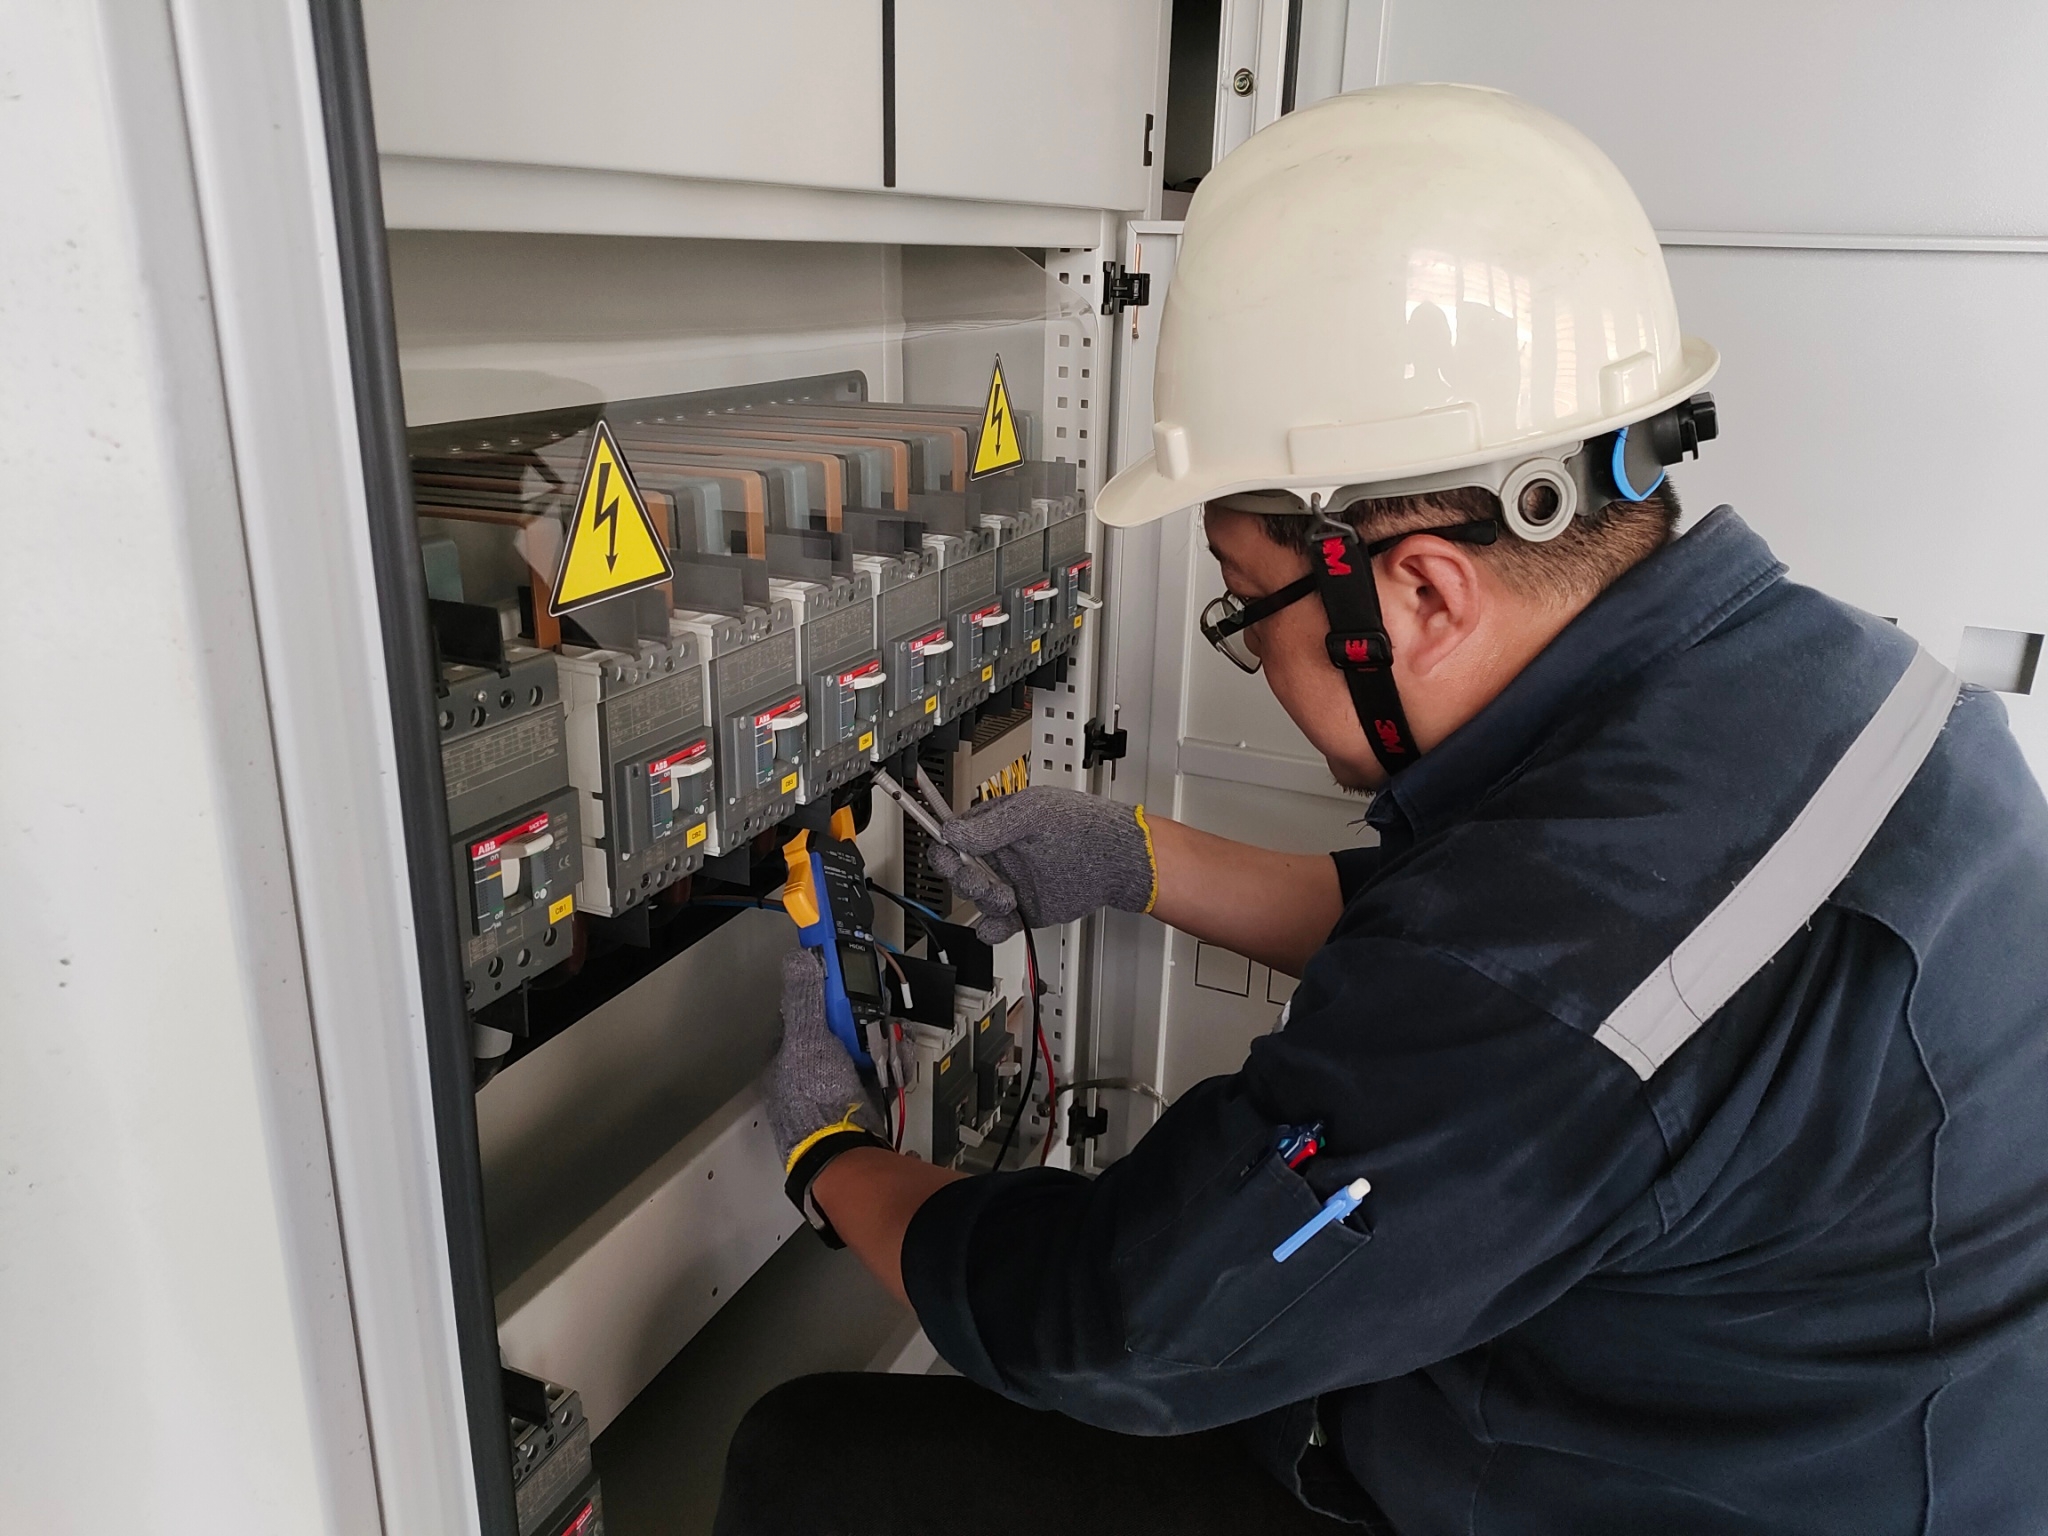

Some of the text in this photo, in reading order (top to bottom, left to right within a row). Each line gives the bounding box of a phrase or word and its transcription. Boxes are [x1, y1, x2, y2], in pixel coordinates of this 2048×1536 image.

[759, 714, 771, 725] ABB
[1374, 720, 1404, 754] 3M
[654, 760, 668, 773] ABB
[785, 778, 794, 787] CB3
[691, 830, 702, 840] CB2
[478, 840, 496, 856] ABB
[490, 852, 500, 862] on
[494, 911, 504, 921] off
[849, 943, 866, 952] HIOKI
